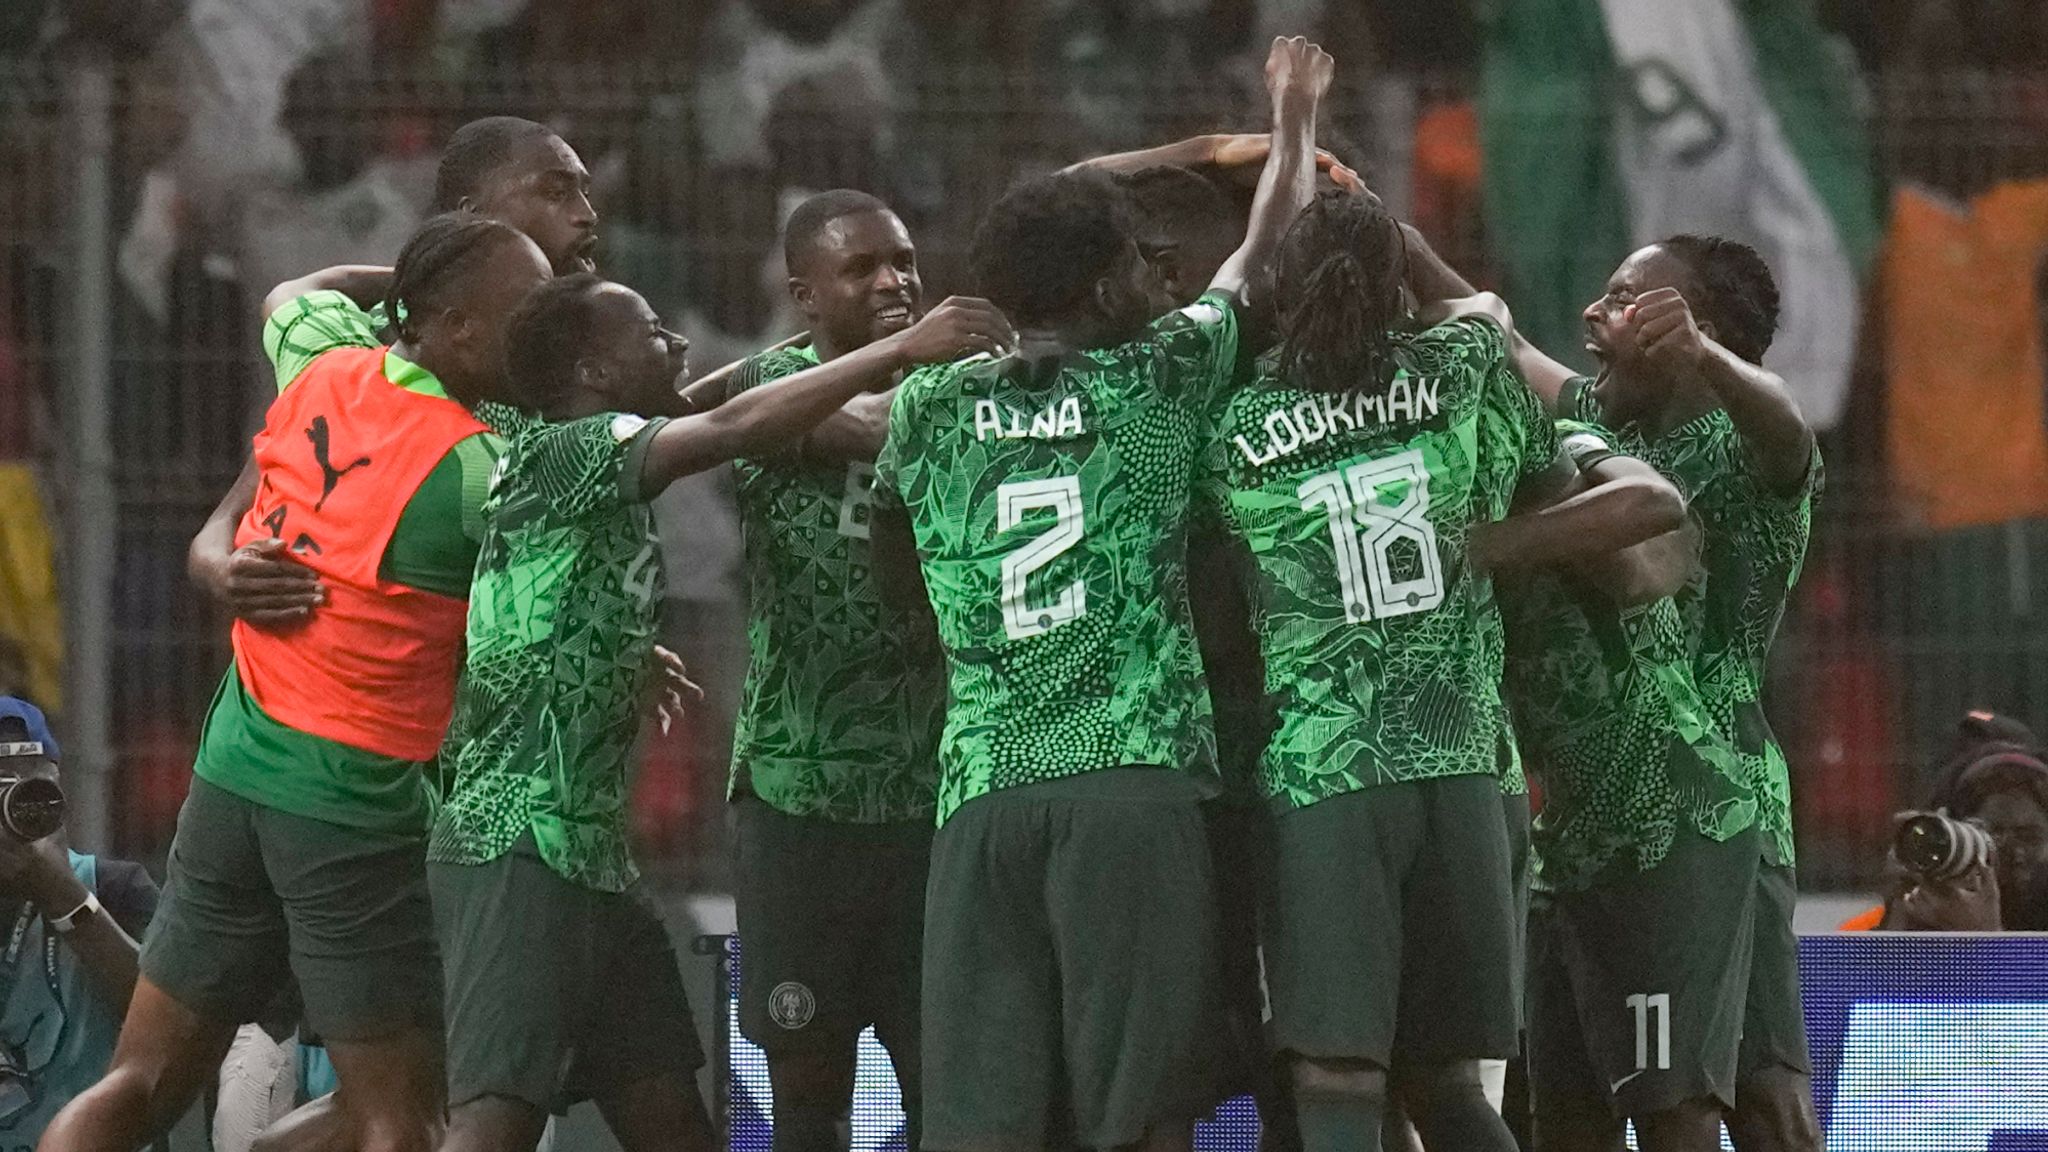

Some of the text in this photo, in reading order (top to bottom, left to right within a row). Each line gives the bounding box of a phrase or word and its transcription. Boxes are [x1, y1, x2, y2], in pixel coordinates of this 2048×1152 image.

[975, 397, 1082, 441] AINA
[1233, 378, 1441, 467] LOOKMAN
[997, 475, 1087, 640] 2
[1298, 448, 1445, 624] 18
[1625, 993, 1670, 1069] 11
